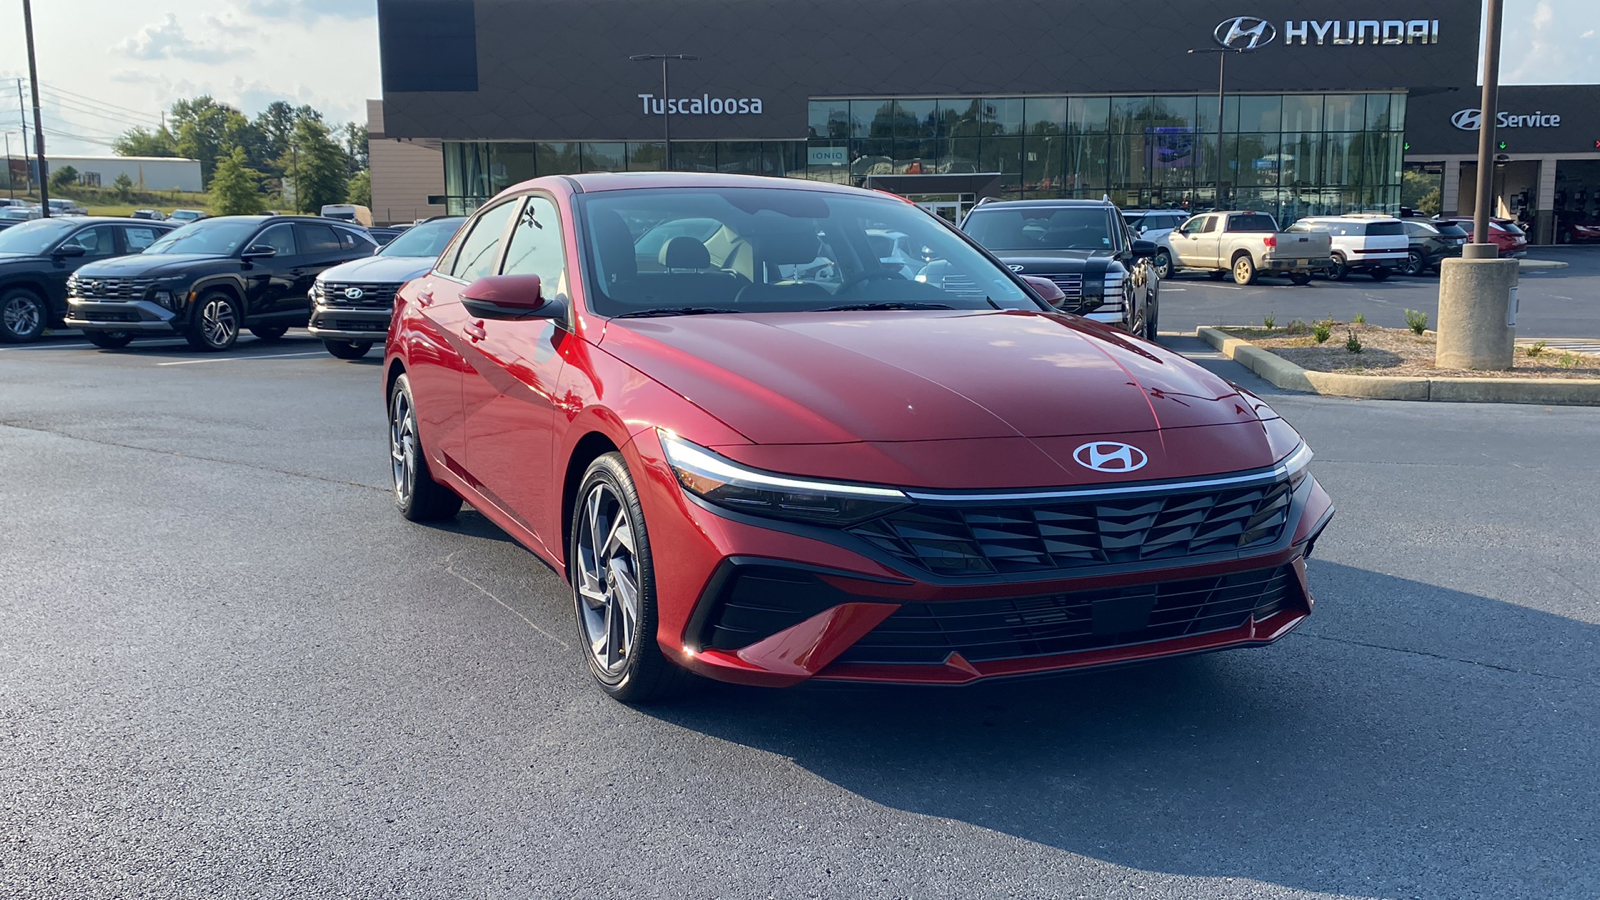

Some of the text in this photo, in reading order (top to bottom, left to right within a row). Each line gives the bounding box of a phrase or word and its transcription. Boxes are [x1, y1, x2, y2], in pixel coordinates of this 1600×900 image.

[1285, 20, 1439, 45] HYUNDAI
[637, 93, 763, 115] Tuscaloosa
[1496, 111, 1561, 128] Service
